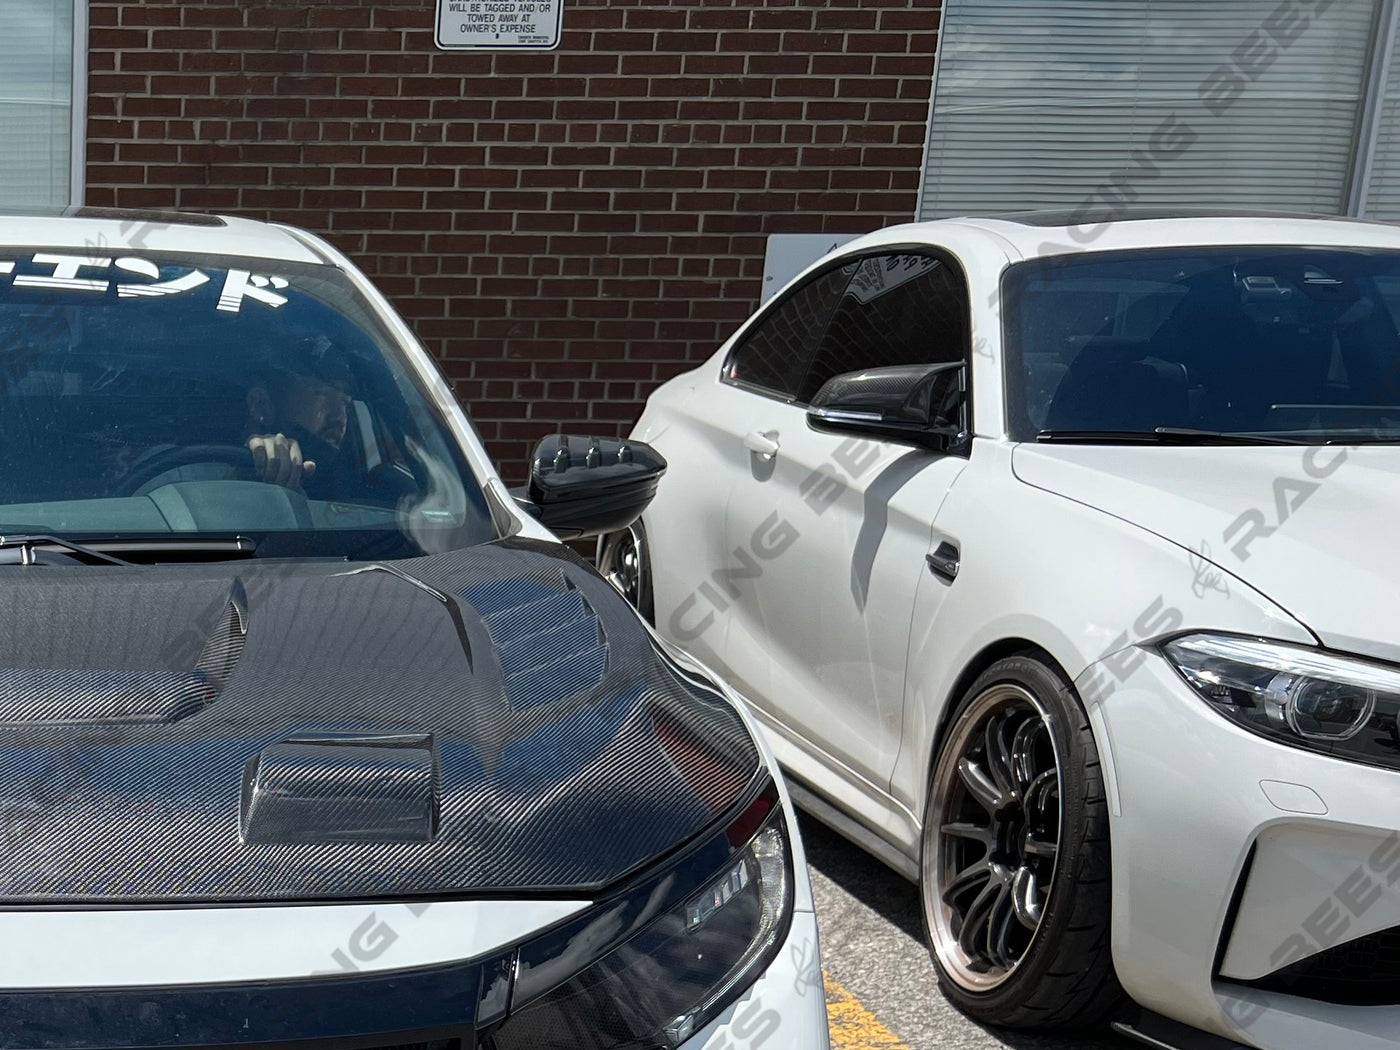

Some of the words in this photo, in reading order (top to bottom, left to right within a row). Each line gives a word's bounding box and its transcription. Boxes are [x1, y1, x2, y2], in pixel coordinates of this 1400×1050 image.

[449, 4, 466, 12] WILL
[470, 4, 480, 12] BE
[484, 4, 515, 12] TAGGED
[518, 4, 551, 12] AND/OR
[467, 14, 495, 22] TOWED
[498, 14, 518, 22] AWAY
[521, 14, 531, 22] AT
[460, 24, 496, 33] OWNER'S
[500, 24, 535, 33] EXPENSE
